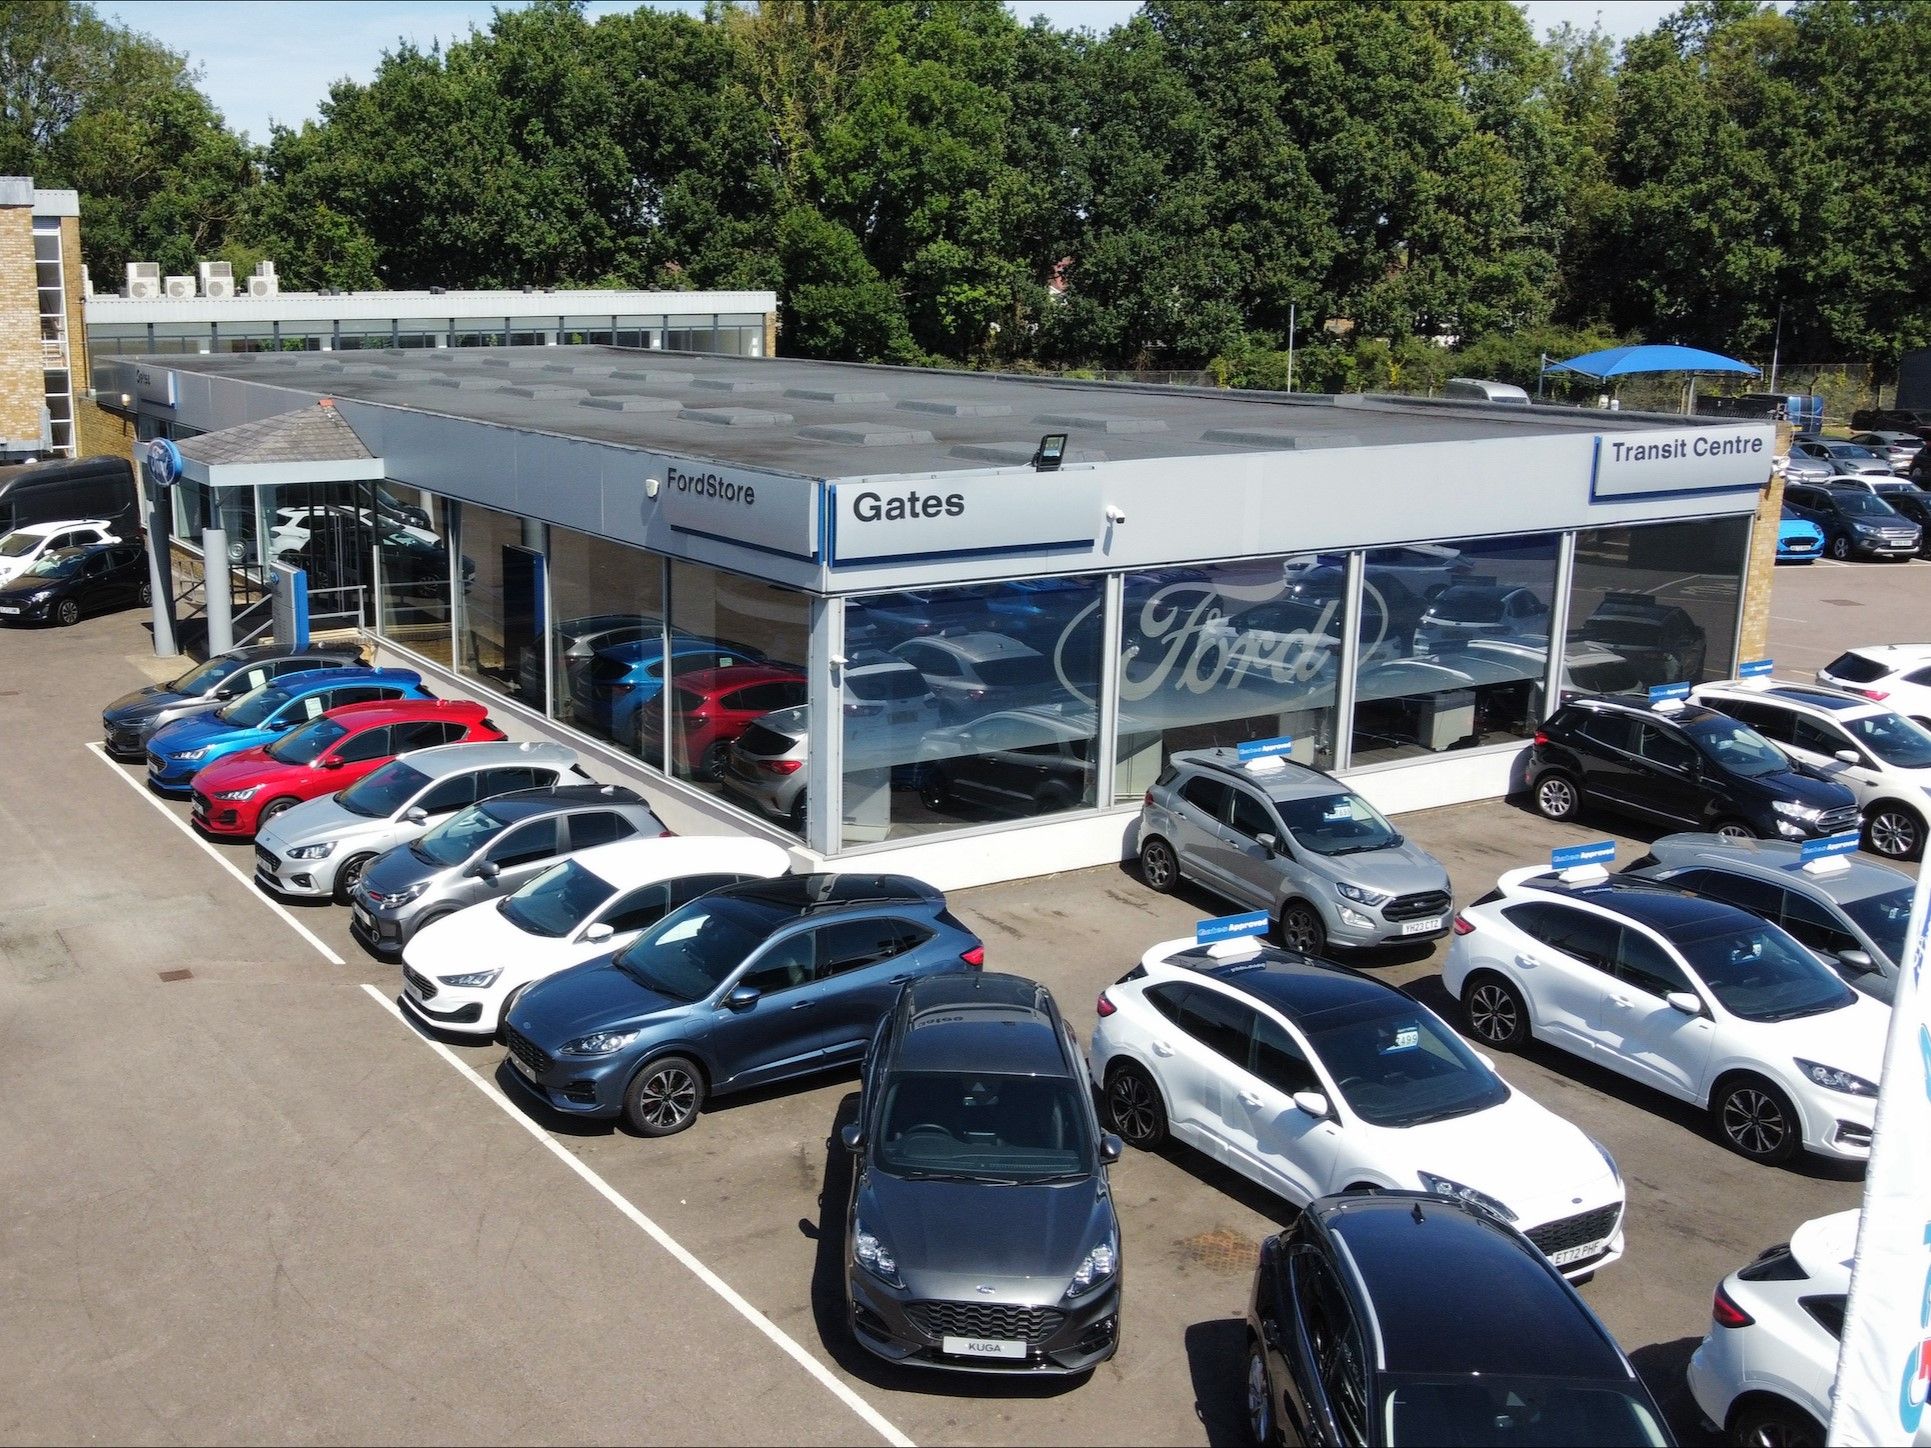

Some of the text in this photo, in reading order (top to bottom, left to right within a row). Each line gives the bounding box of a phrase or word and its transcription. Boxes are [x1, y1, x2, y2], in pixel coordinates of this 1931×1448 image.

[1612, 435, 1763, 462] Transit Centre
[667, 467, 755, 506] FordStore
[853, 490, 965, 522] Gates
[1119, 580, 1340, 701] Ford
[1262, 741, 1291, 752] Approved
[1580, 847, 1615, 859] Approved
[1826, 838, 1859, 850] Approved
[1228, 917, 1268, 931] Approved
[1555, 1241, 1600, 1264] ET72 PHF
[968, 1342, 1002, 1353] KUGA
